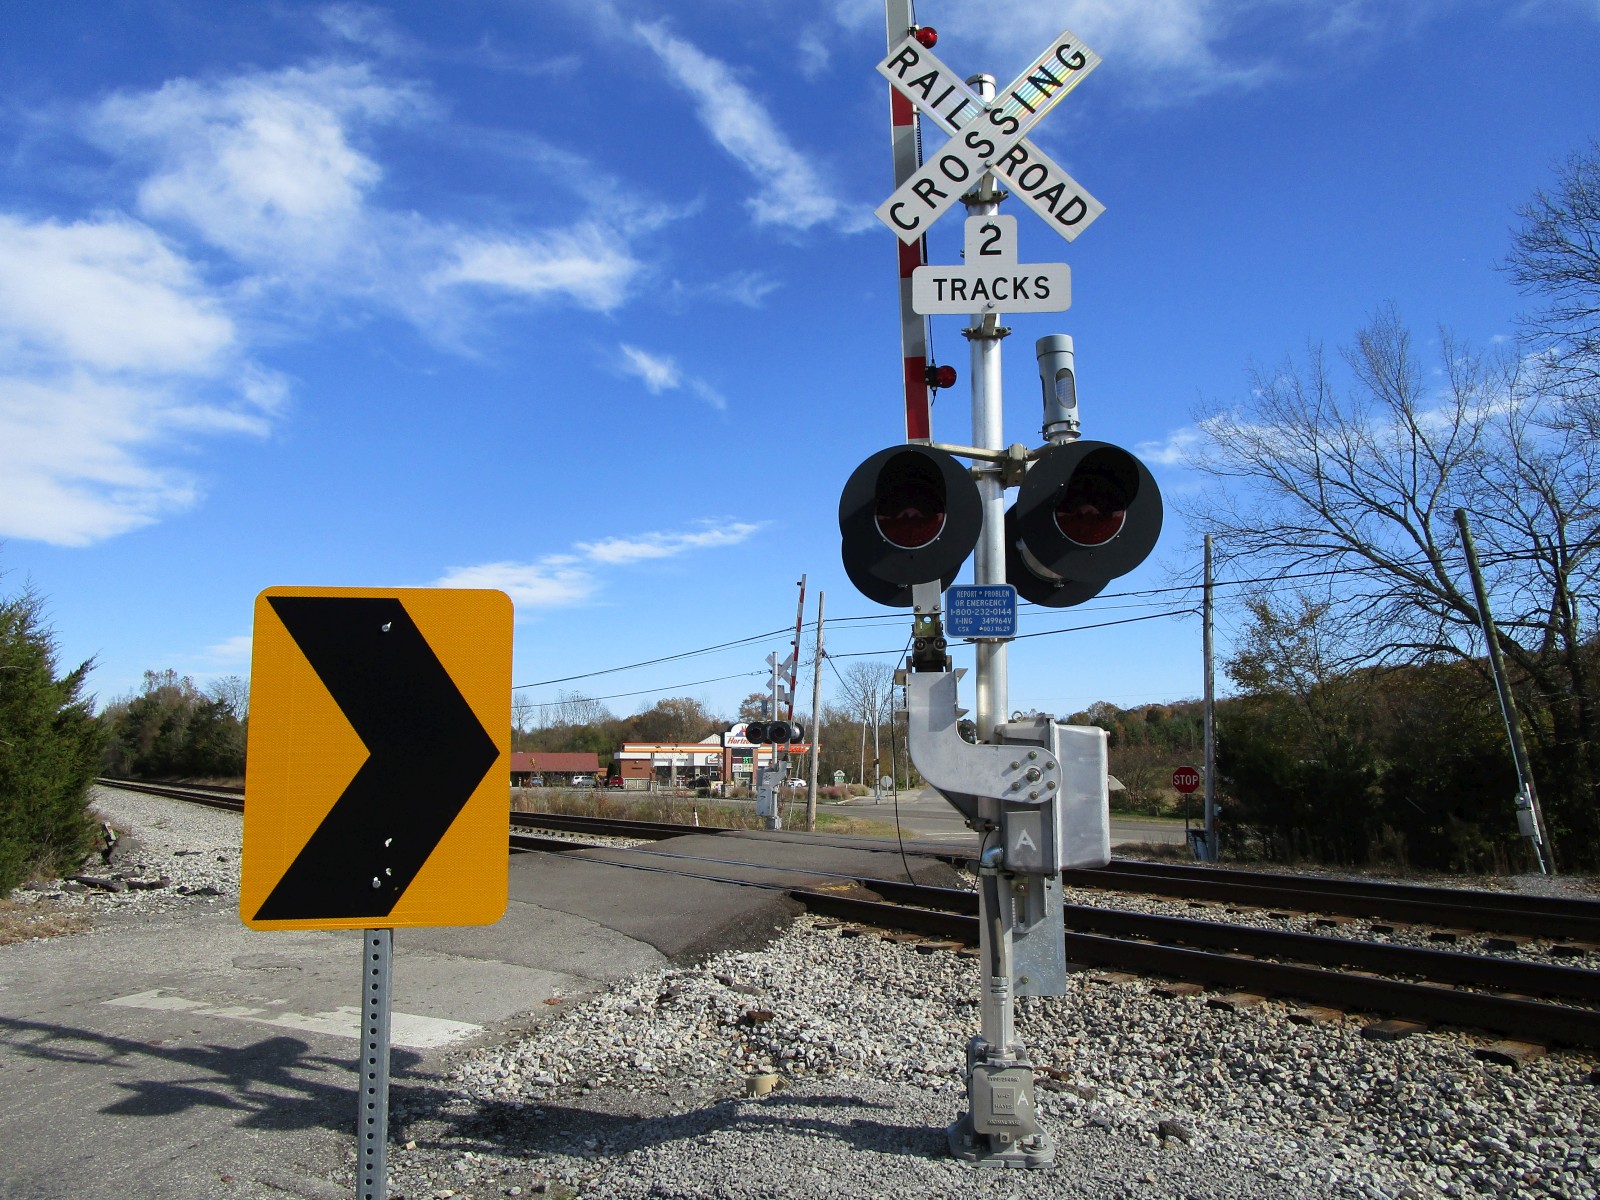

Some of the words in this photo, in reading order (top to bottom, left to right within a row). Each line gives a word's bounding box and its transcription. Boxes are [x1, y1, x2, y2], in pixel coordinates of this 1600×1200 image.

[890, 44, 1086, 230] CROSSING
[979, 224, 1002, 256] 2
[932, 275, 1050, 301] TRACKS
[950, 608, 1012, 616] 1-800-232-0144
[1174, 775, 1199, 785] STOP
[1015, 828, 1036, 851] A
[1017, 1089, 1029, 1105] A
